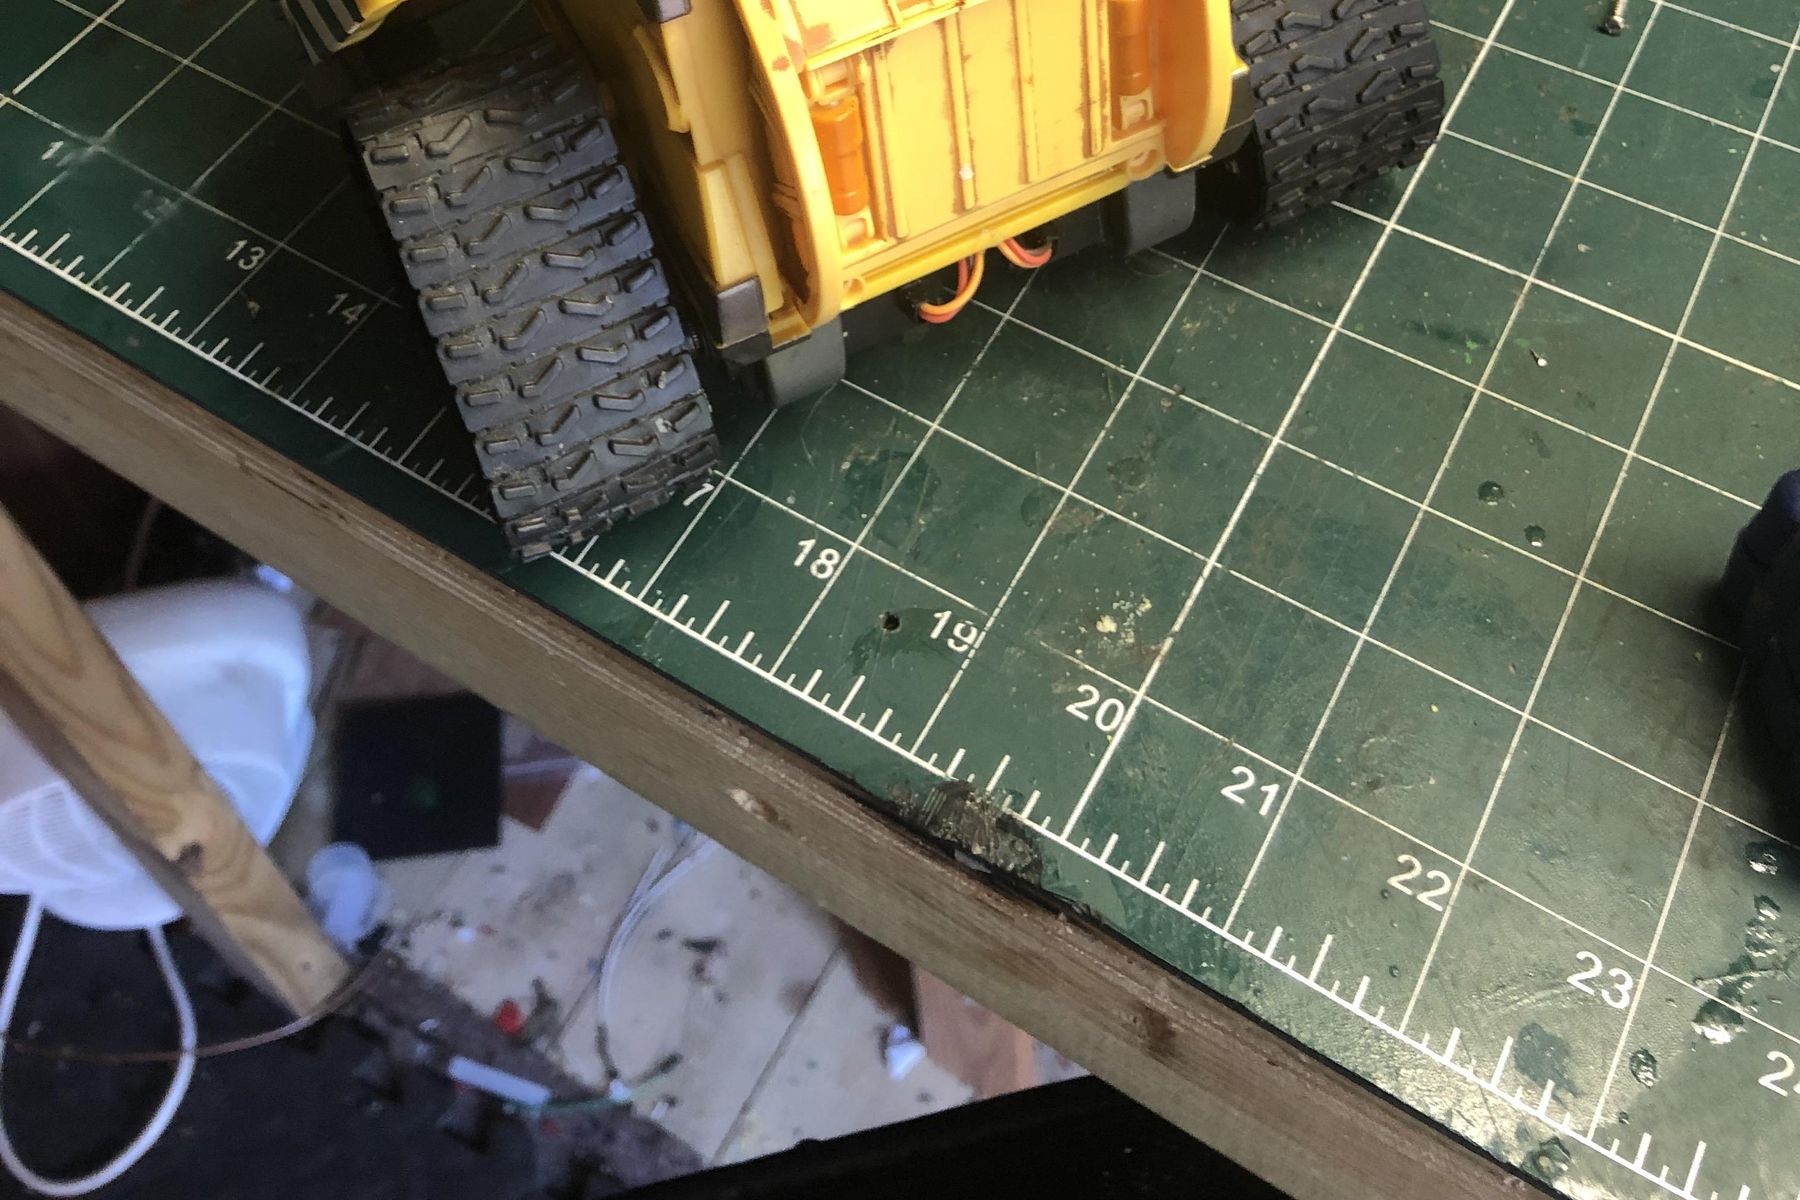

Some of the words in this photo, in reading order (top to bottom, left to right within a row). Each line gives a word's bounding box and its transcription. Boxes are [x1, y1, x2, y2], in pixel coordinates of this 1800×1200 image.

[225, 239, 266, 271] 13
[327, 293, 367, 325] 14
[793, 538, 841, 580] 18
[929, 610, 978, 653] 19
[1066, 684, 1125, 733] 20
[1221, 766, 1281, 816] 21
[1387, 855, 1453, 912] 22
[1567, 951, 1634, 1010] 23
[1758, 1050, 1800, 1097] 2
